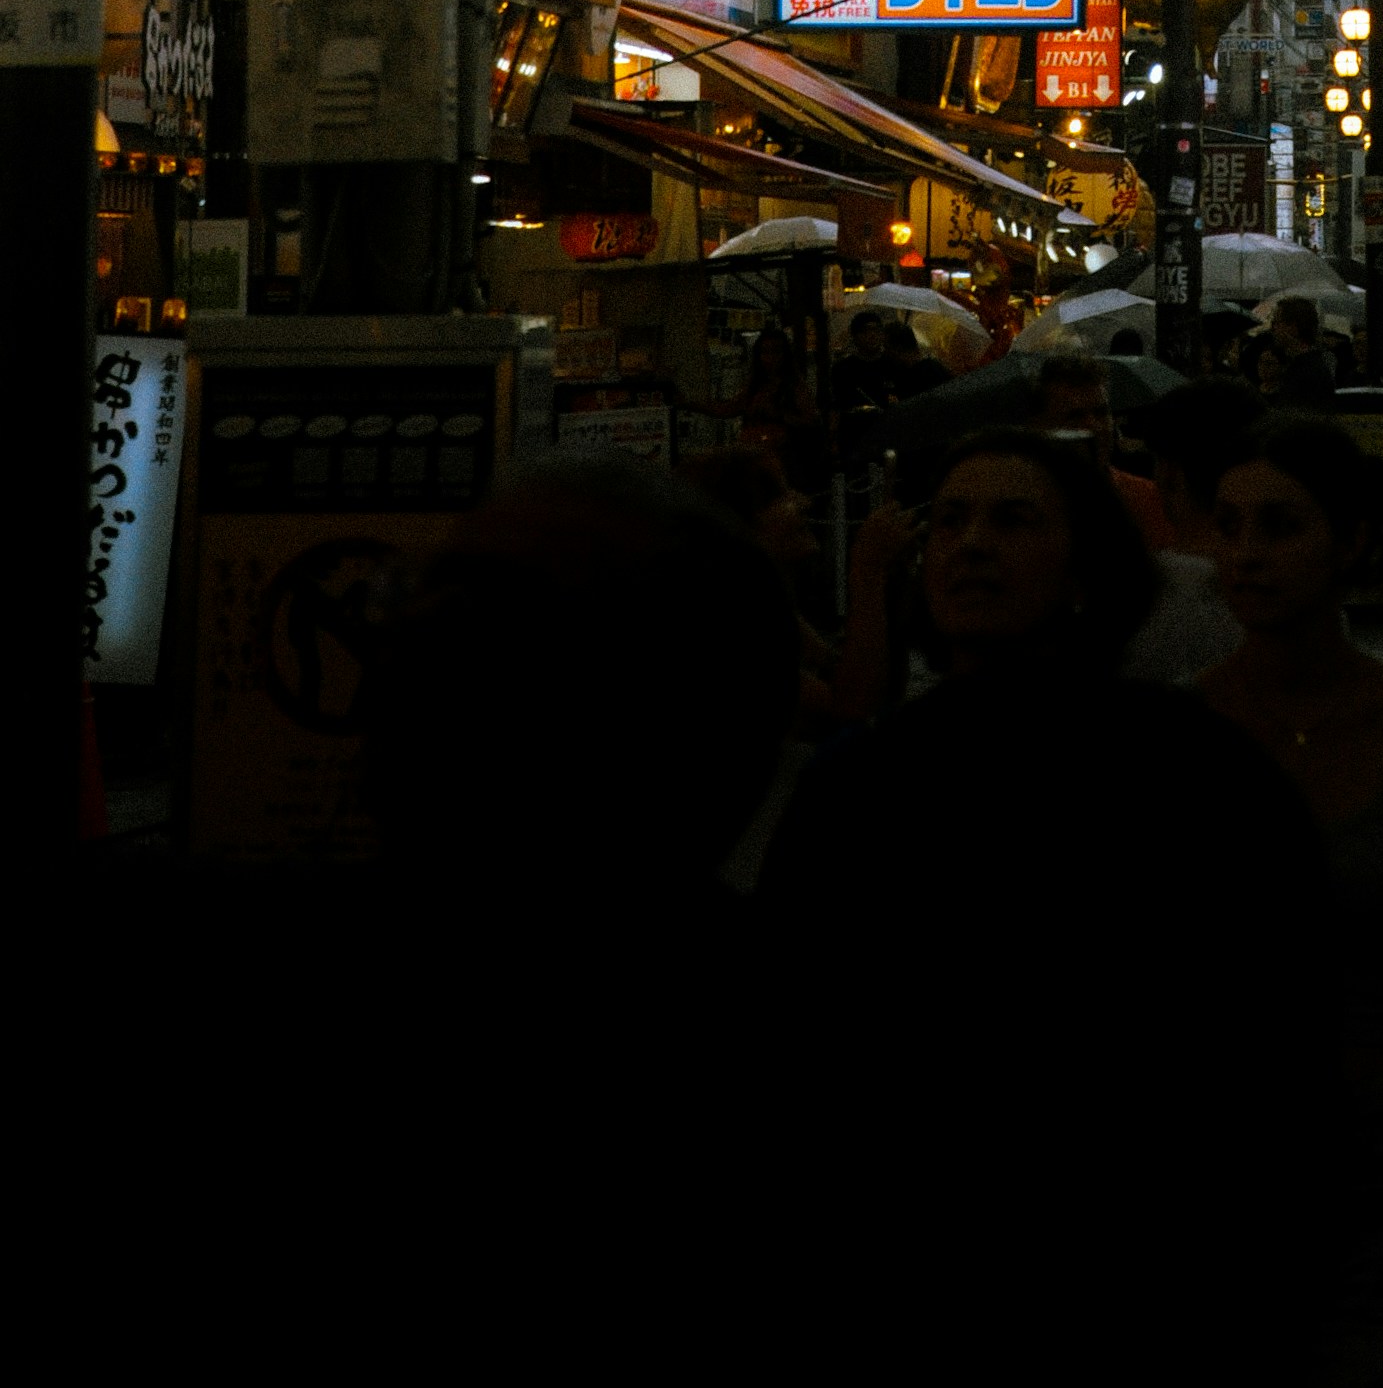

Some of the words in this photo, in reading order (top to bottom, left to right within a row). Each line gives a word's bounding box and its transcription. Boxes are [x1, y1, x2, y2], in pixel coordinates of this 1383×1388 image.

[837, 6, 871, 18] FREE
[1236, 39, 1285, 52] WORLD
[1039, 50, 1109, 67] JINJYA
[1066, 81, 1090, 98] B1
[152, 353, 181, 467] 創業昭和四年
